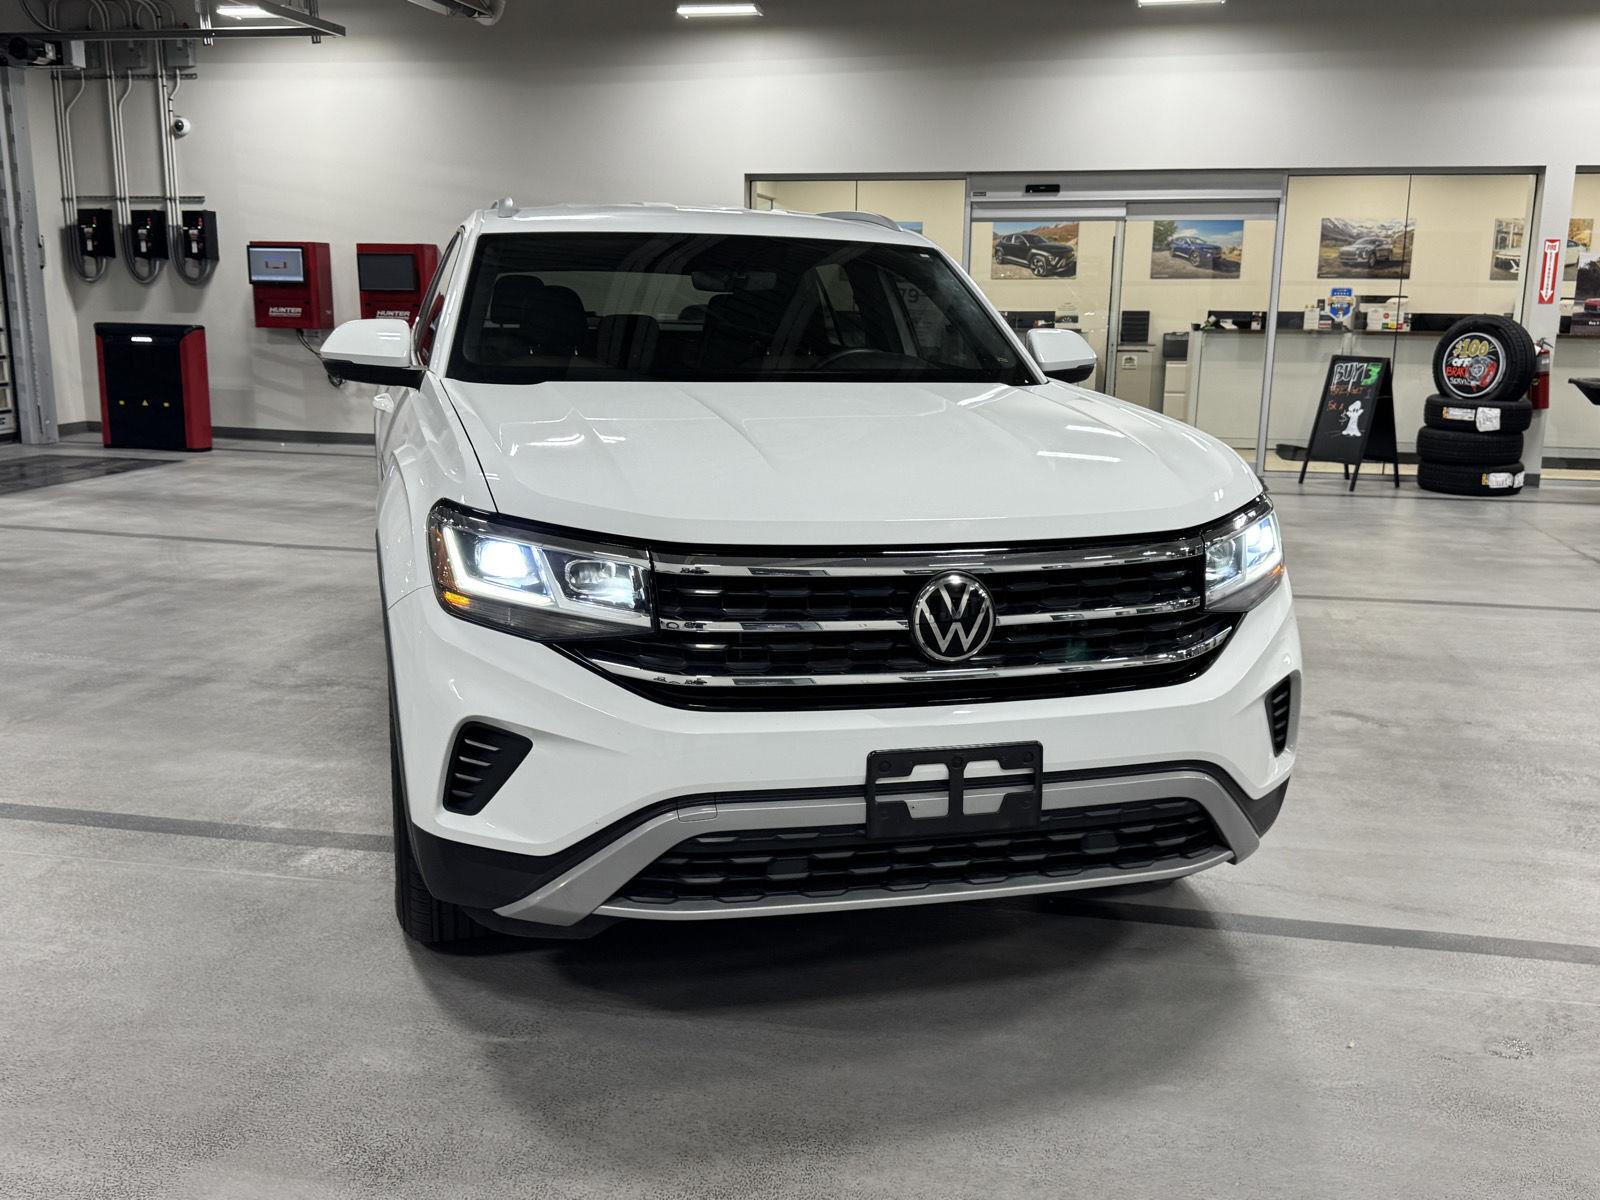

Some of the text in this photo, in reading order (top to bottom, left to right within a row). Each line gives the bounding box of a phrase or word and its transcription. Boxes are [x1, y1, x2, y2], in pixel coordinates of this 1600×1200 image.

[1452, 338, 1489, 358] $100
[1452, 357, 1472, 367] OFF
[1332, 362, 1382, 386] BUY 3
